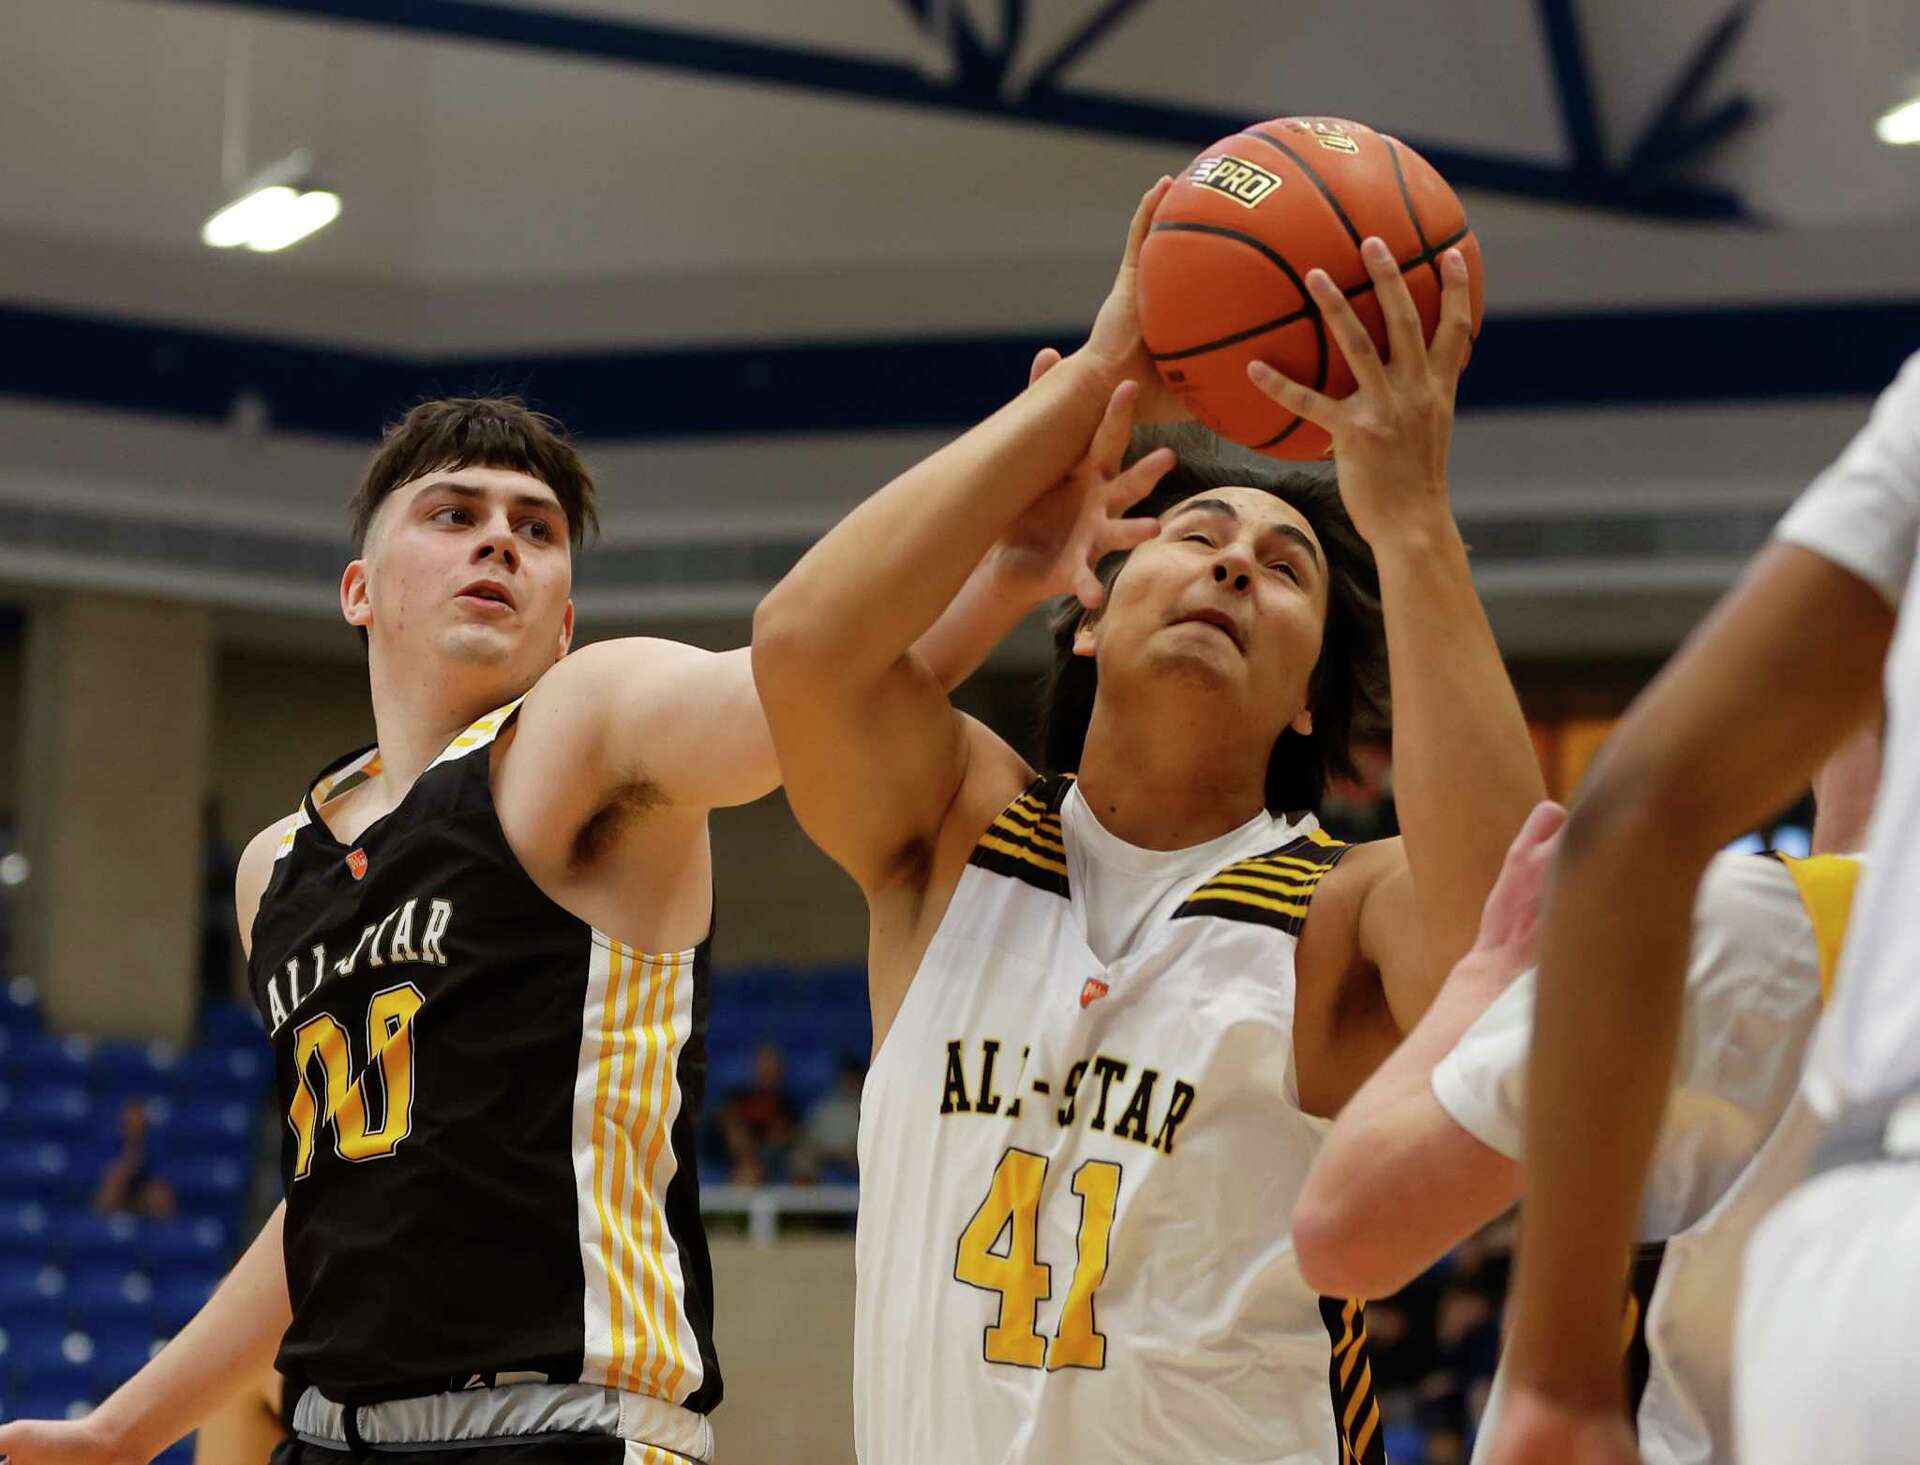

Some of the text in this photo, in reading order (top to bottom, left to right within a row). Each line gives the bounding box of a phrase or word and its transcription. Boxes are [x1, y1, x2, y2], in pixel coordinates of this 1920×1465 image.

[1206, 159, 1272, 200] PRO
[939, 1040, 1196, 1154] AL-STAR
[953, 1147, 1123, 1371] 41
